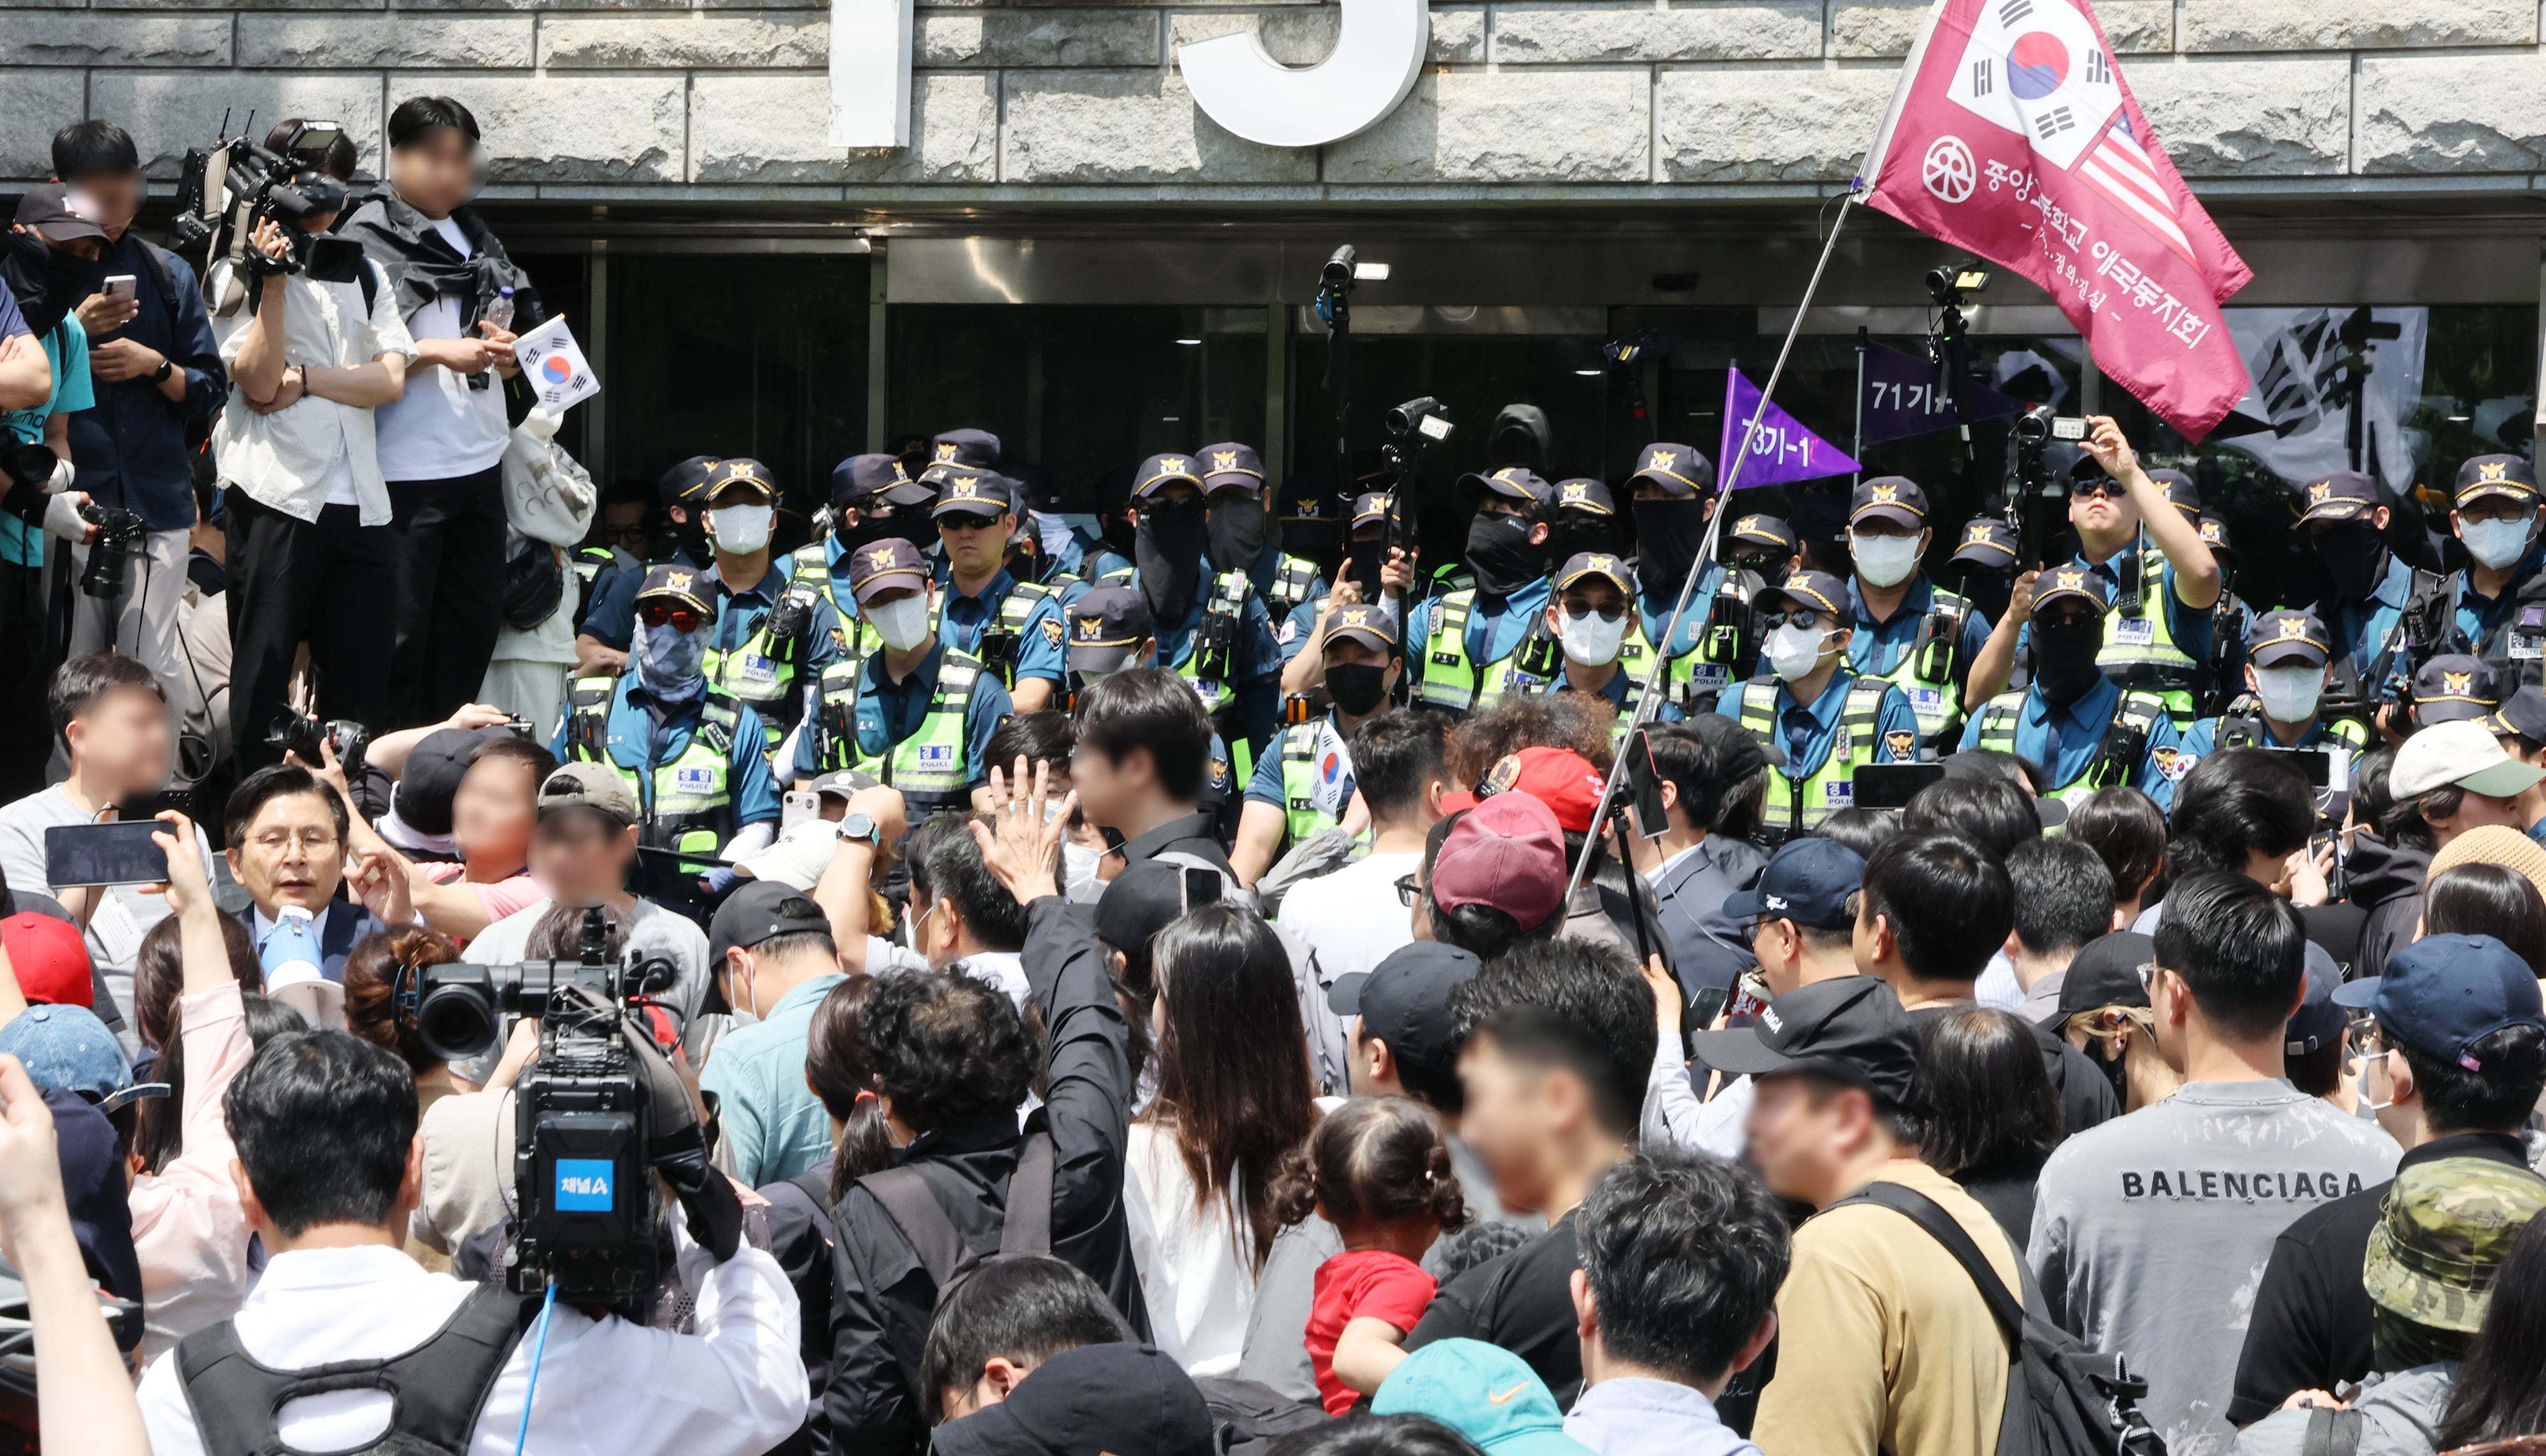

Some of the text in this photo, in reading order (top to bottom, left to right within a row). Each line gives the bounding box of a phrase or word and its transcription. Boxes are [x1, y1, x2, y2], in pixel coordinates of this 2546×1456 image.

[2091, 241, 2211, 350] 애국동지회
[1872, 382, 1957, 415] 71기-
[745, 668, 773, 678] POLICE
[1696, 665, 1725, 678] 경찰
[921, 746, 950, 759] 경찰
[680, 769, 710, 782] 경찰
[561, 1176, 608, 1195] 채널A
[2123, 1170, 2363, 1198] BALENCIAGA
